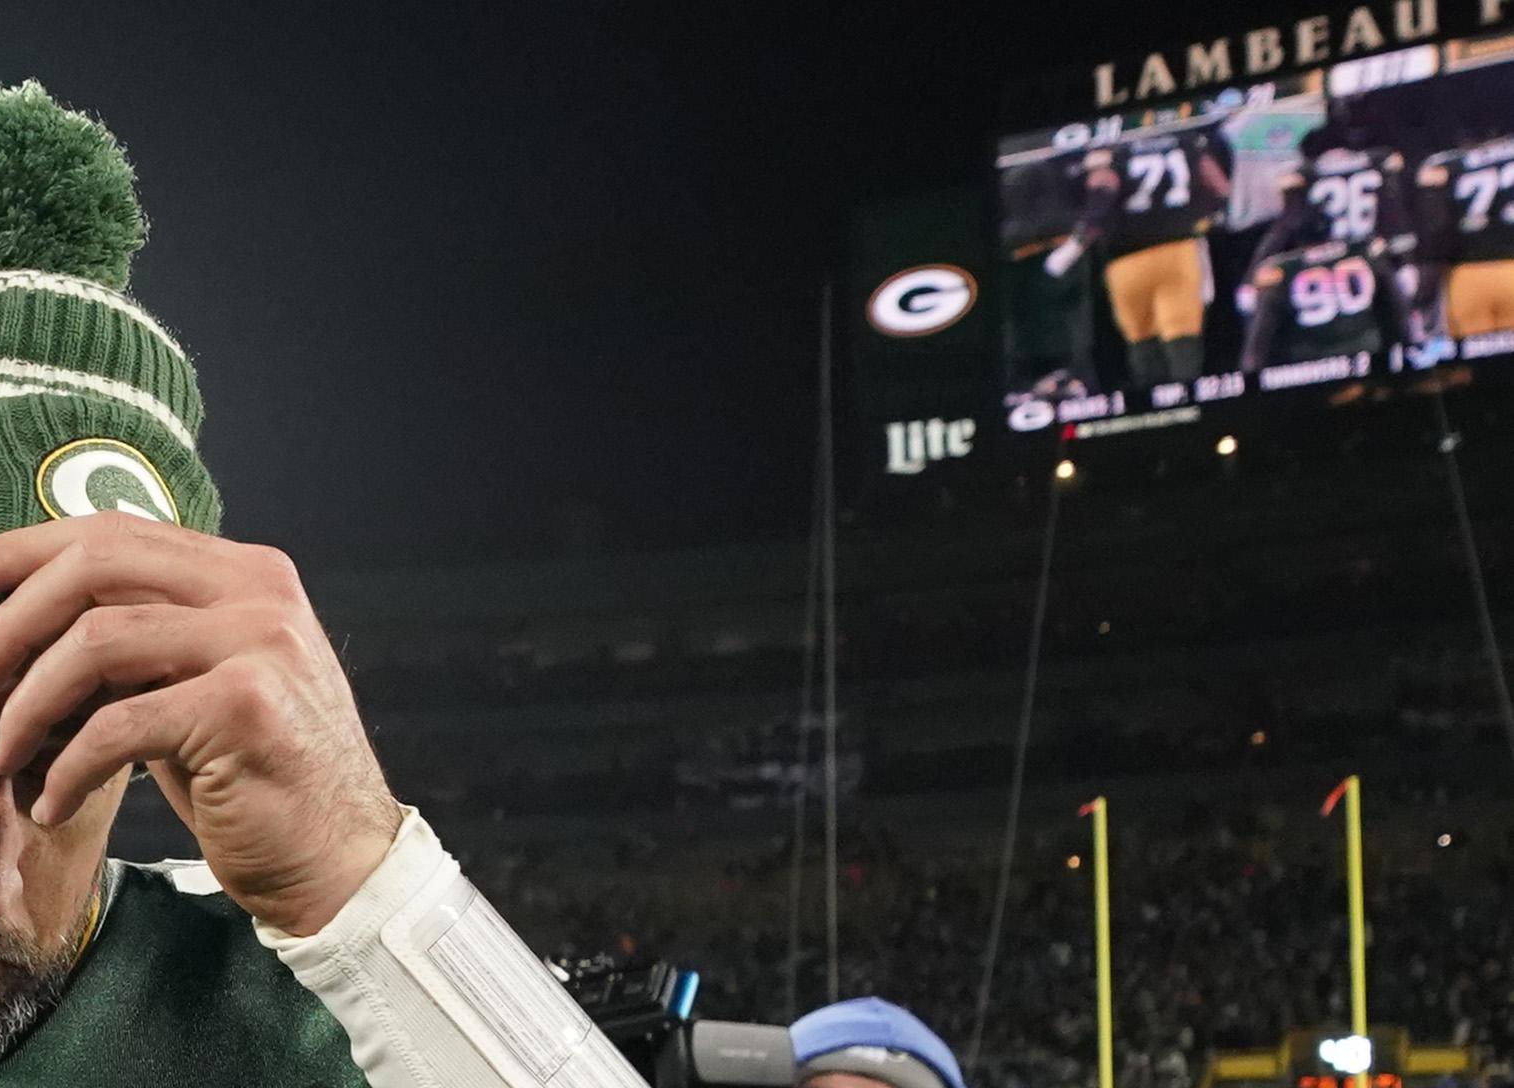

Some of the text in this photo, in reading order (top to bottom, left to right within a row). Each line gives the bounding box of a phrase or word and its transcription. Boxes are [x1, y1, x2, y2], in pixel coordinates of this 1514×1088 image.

[1094, 0, 1438, 106] LAMBEAU
[1125, 150, 1191, 213] 71
[870, 266, 973, 334] G
[1290, 256, 1376, 327] 90
[886, 417, 977, 474] Lite
